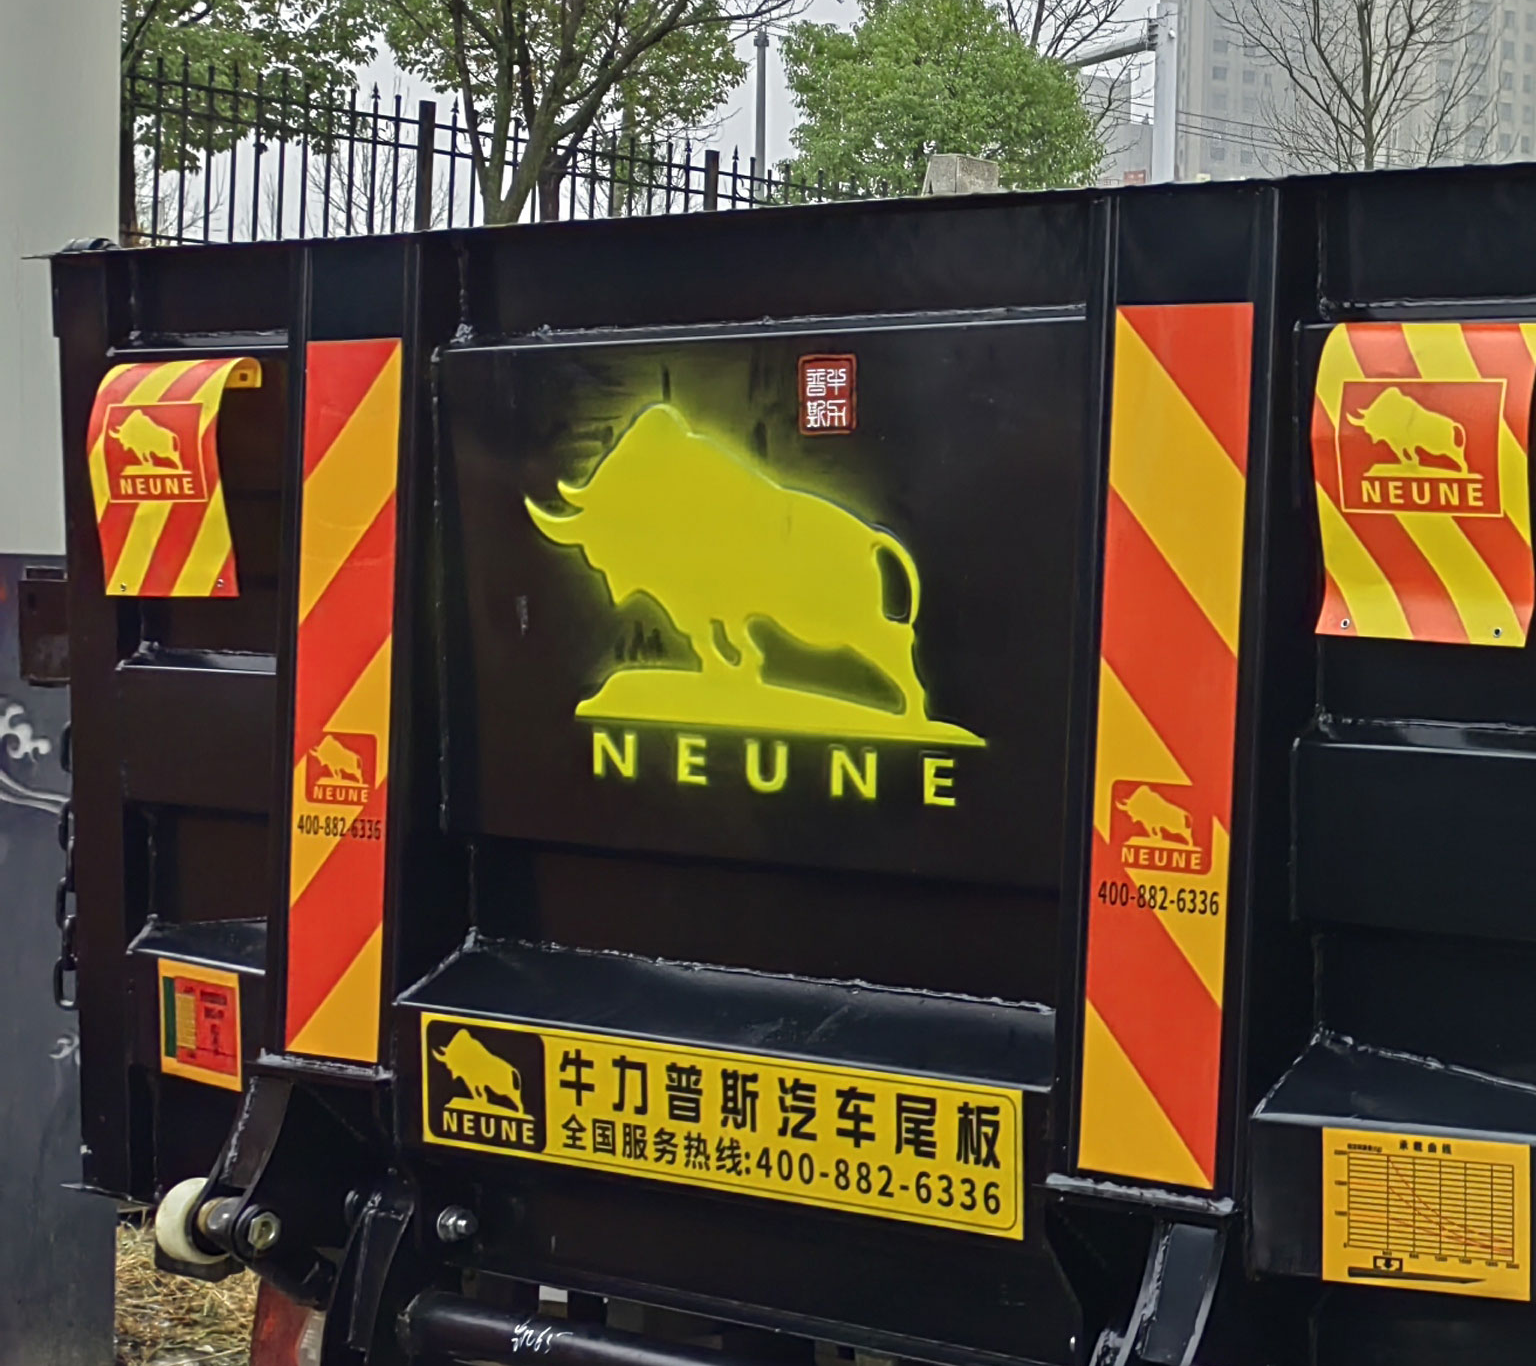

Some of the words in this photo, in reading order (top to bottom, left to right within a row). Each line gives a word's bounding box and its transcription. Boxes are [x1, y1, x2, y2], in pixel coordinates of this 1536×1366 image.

[120, 478, 195, 495] NEUNE
[1361, 480, 1484, 507] NEUNE
[592, 729, 958, 807] NEUNE
[313, 785, 369, 803] NEUNE
[297, 814, 382, 841] 400-882-6336
[1121, 846, 1203, 871] NEUNE
[1097, 880, 1220, 916] 400-882-6336
[559, 1049, 1001, 1169] 牛力普斯汽车尾板
[442, 1110, 536, 1145] NEUNE
